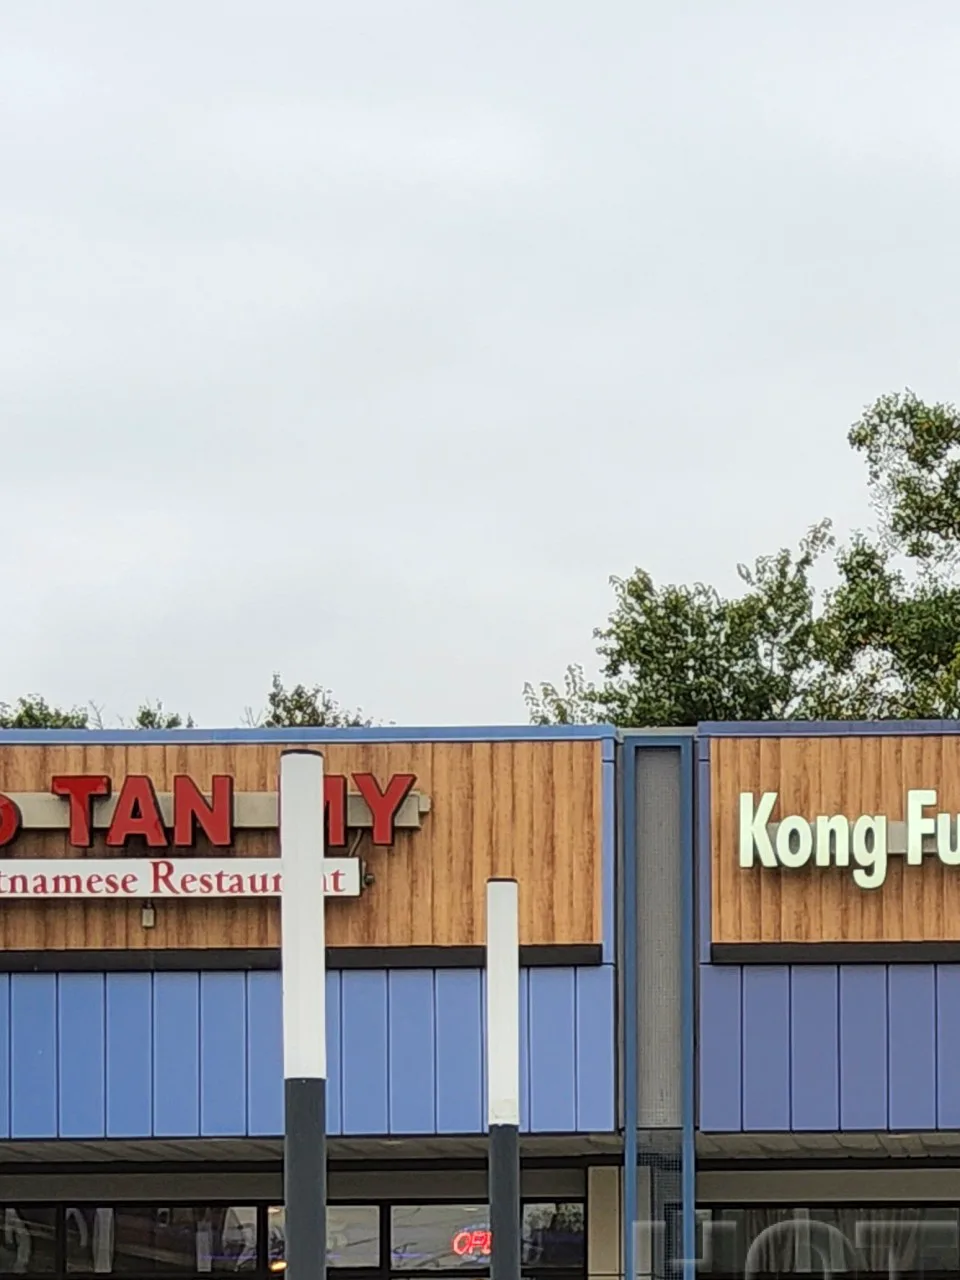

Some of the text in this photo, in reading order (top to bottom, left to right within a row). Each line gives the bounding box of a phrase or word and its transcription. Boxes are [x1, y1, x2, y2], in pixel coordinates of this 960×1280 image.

[52, 774, 234, 848] TAN
[739, 791, 888, 889] Kong
[150, 860, 346, 895] Restaurt
